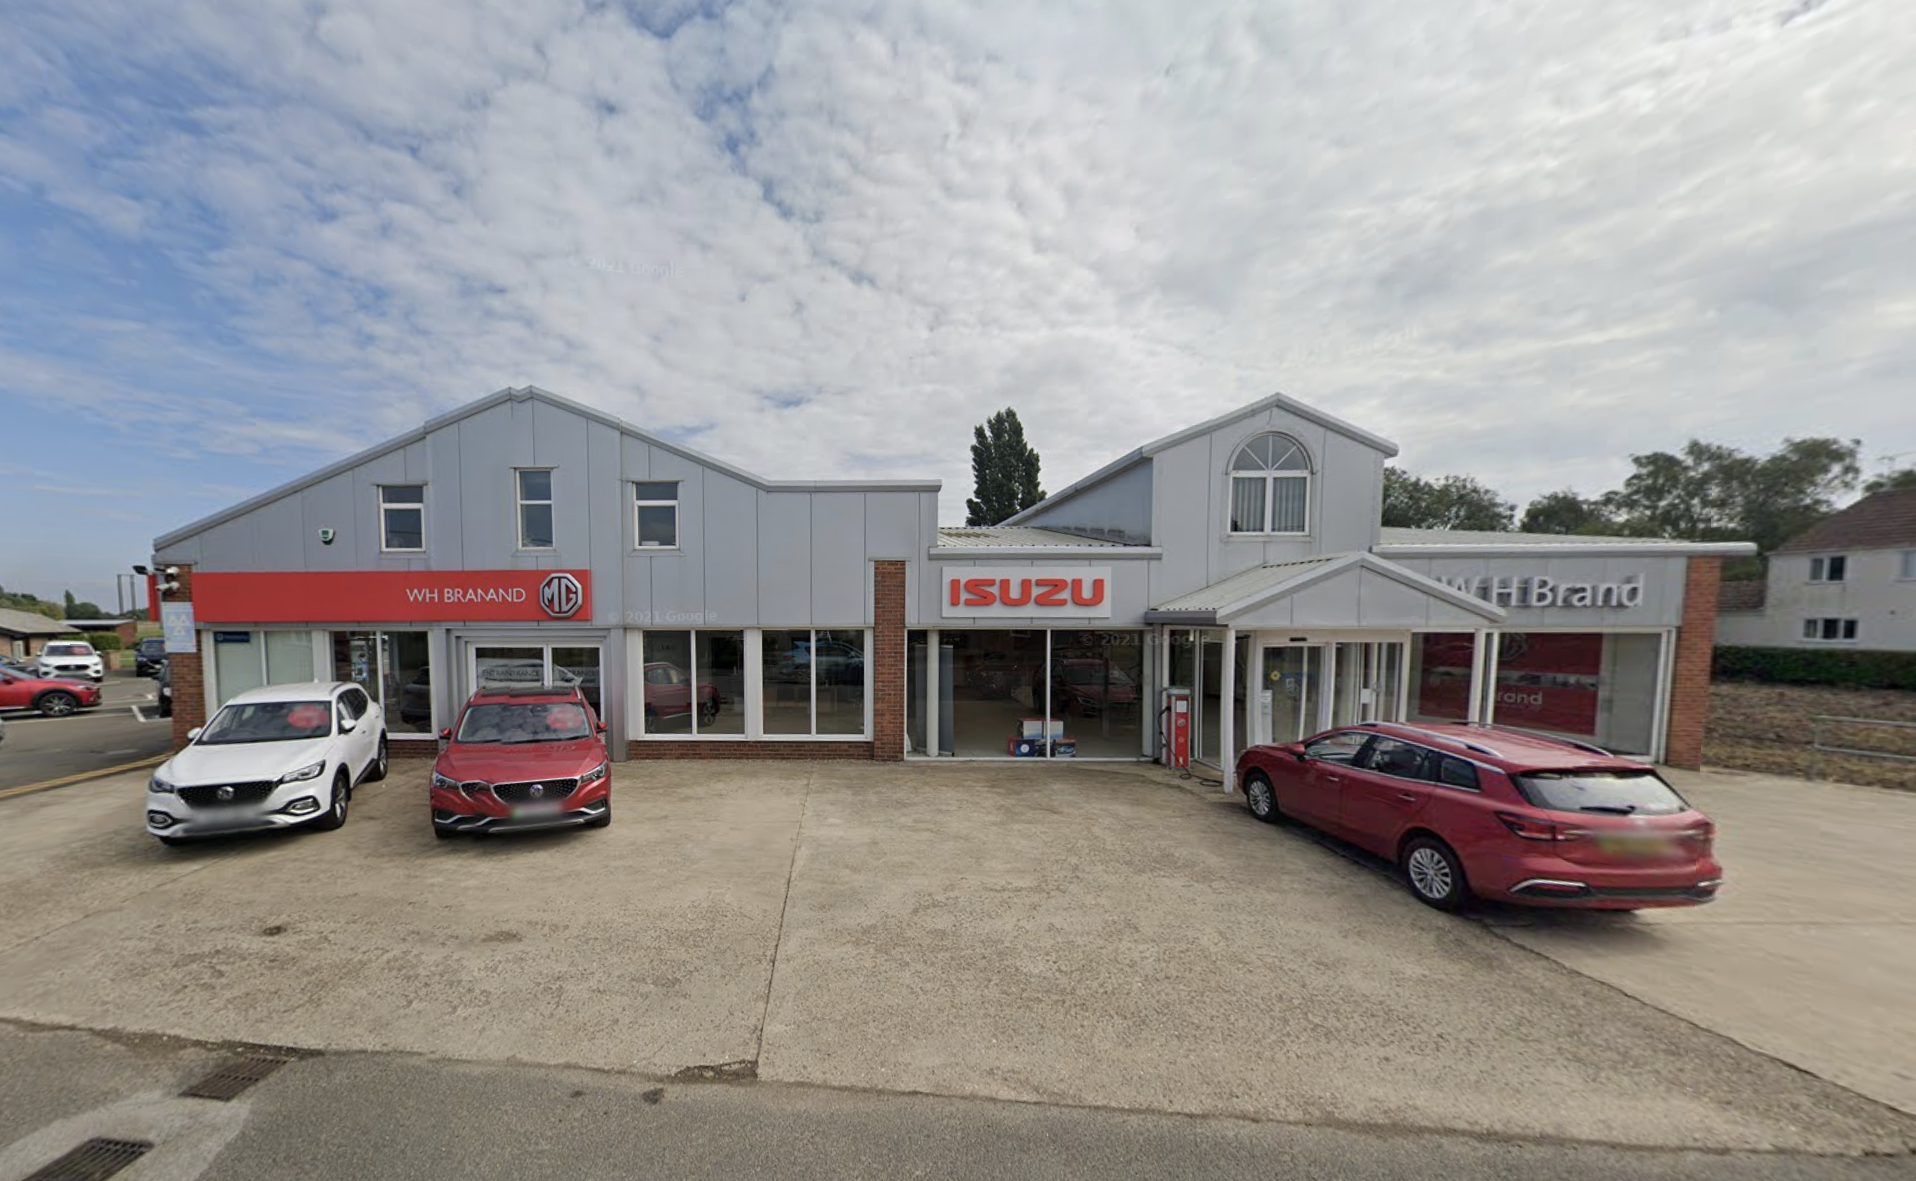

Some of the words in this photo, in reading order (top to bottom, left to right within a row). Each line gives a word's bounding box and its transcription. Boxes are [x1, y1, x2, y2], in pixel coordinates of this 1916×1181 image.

[405, 588, 438, 603] WH
[544, 577, 577, 613] MG
[950, 578, 1104, 607] ISUZU
[1492, 577, 1518, 606] H
[1531, 574, 1644, 608] Brand
[1497, 690, 1543, 705] rand
